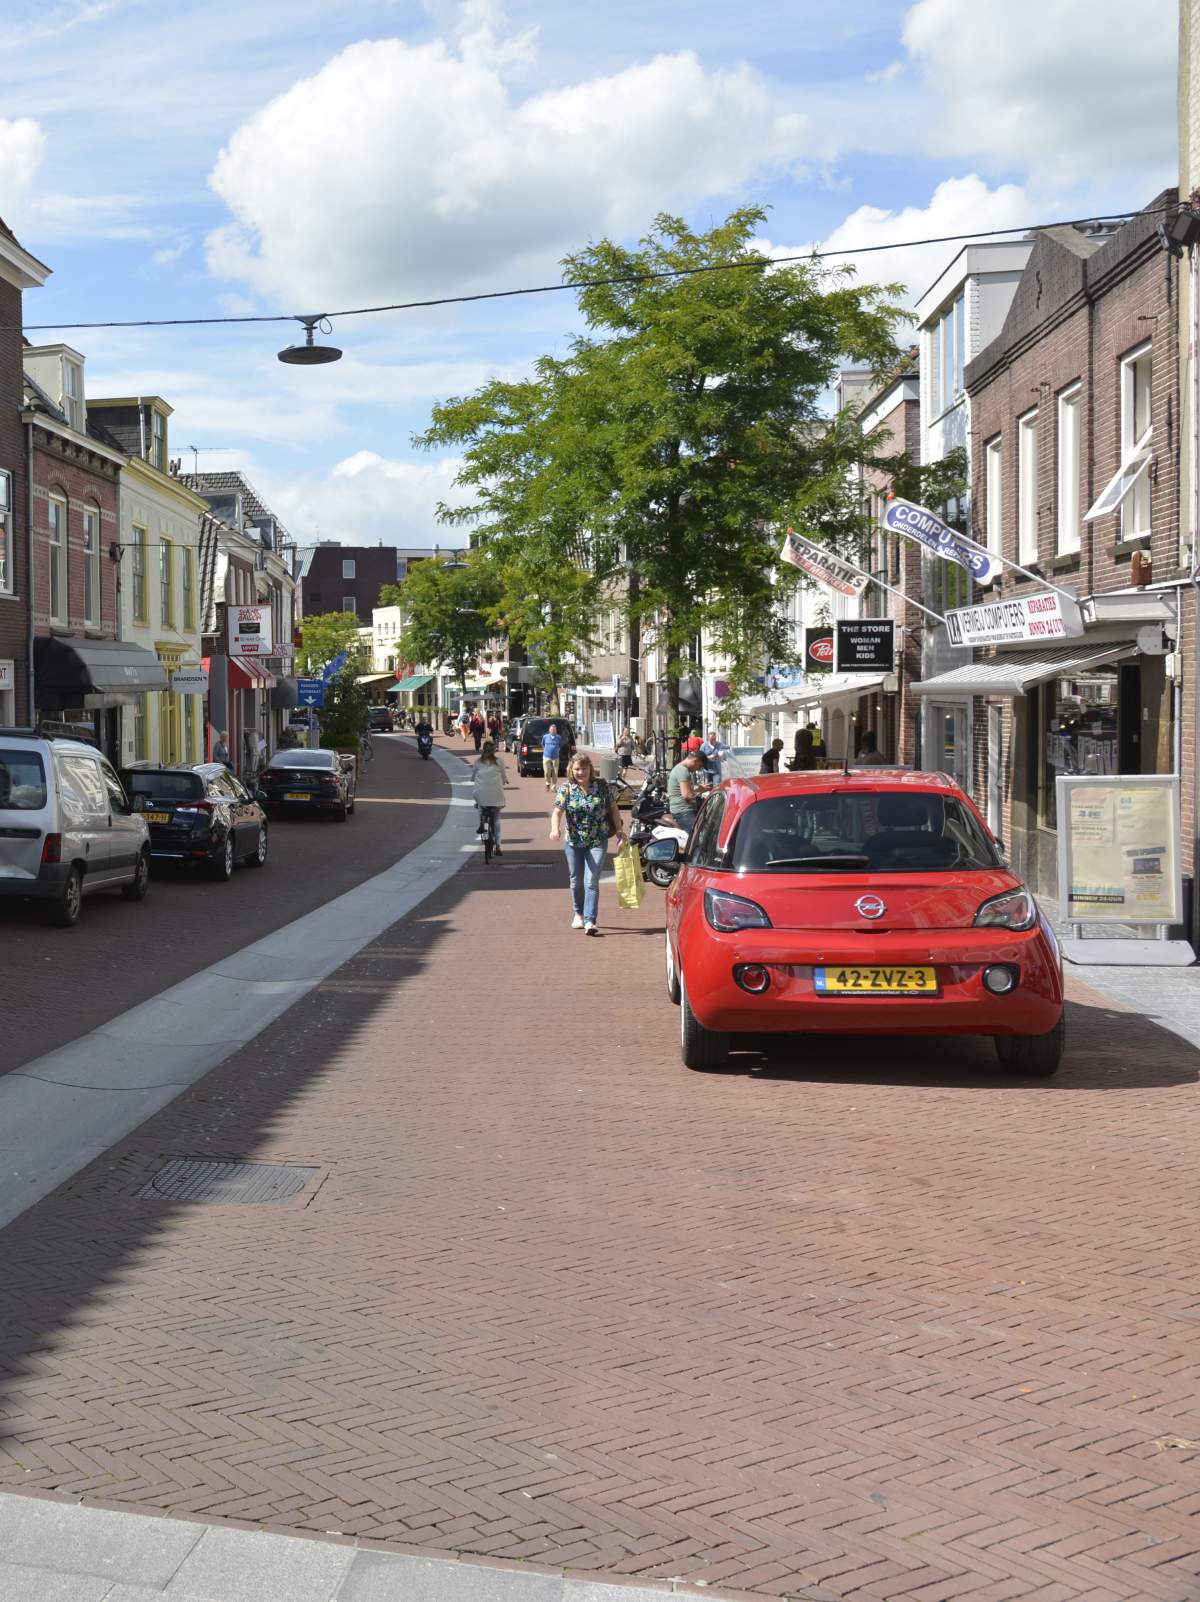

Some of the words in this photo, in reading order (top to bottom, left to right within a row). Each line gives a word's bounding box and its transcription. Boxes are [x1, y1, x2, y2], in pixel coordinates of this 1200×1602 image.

[1027, 597, 1057, 614] REPARATIES
[984, 602, 1025, 630] COMPUTERS
[836, 970, 928, 987] 42-ZVZ-3
